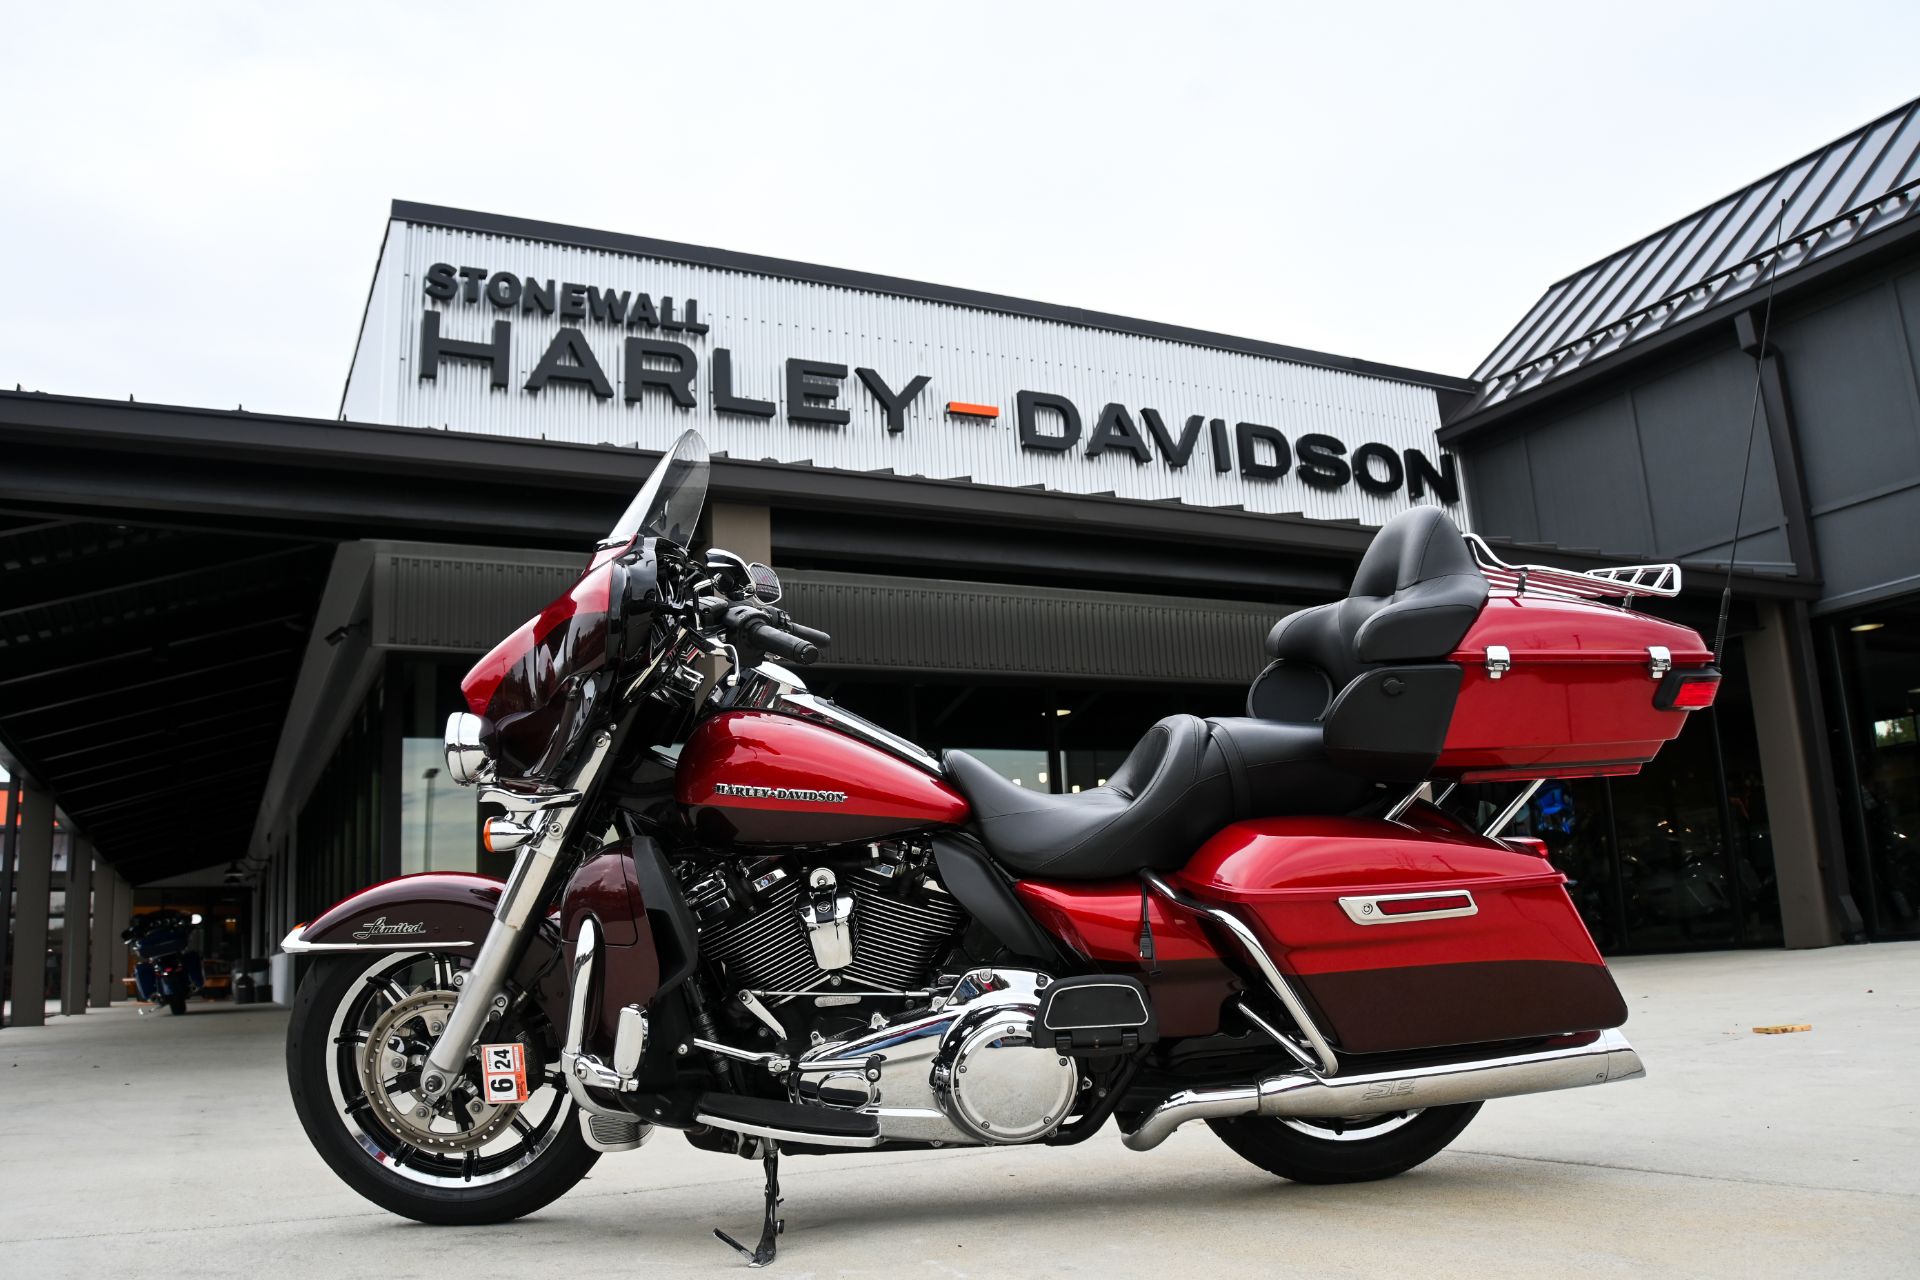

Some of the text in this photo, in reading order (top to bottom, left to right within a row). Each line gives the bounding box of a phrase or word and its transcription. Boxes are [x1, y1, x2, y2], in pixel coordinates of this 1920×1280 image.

[424, 262, 709, 335] STONEWALL
[352, 916, 427, 939] Limited
[490, 1048, 514, 1093] 6 24
